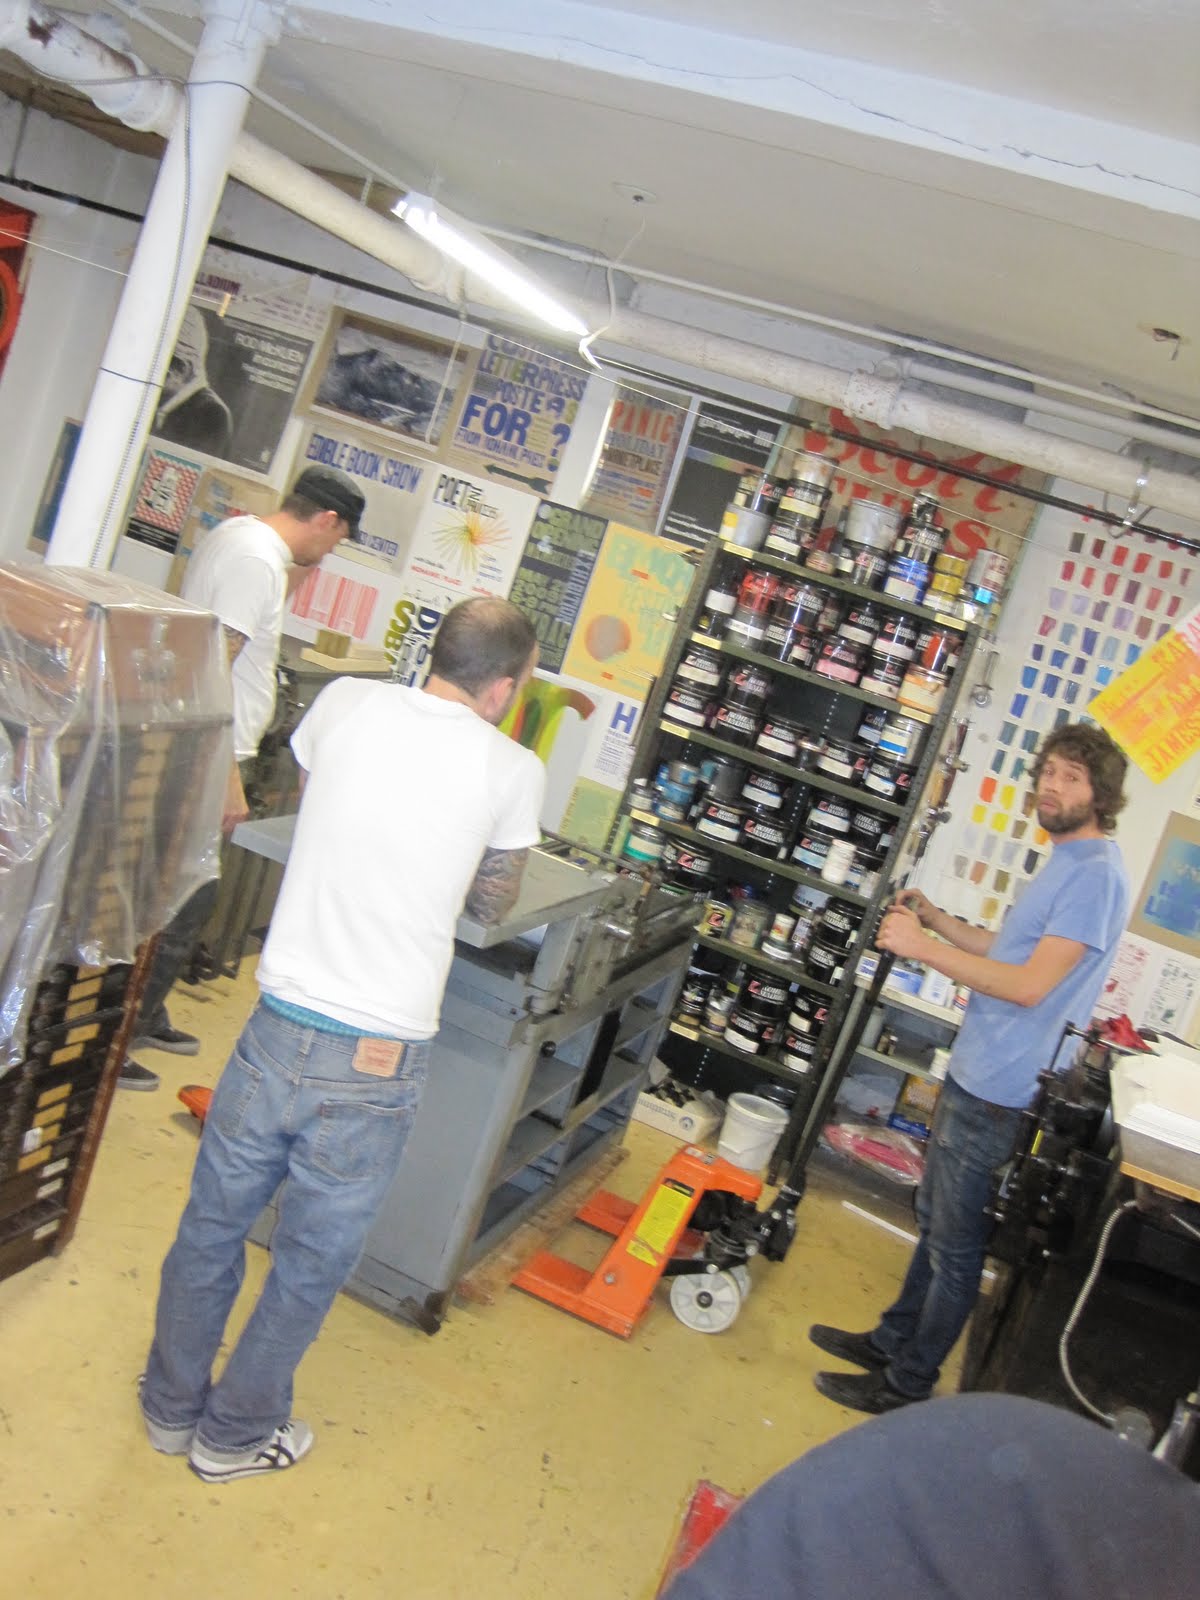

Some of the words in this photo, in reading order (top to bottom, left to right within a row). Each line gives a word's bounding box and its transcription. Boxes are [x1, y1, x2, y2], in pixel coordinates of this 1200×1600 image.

[460, 395, 532, 446] FOR
[609, 401, 674, 442] PANIC
[381, 458, 422, 492] SHOW
